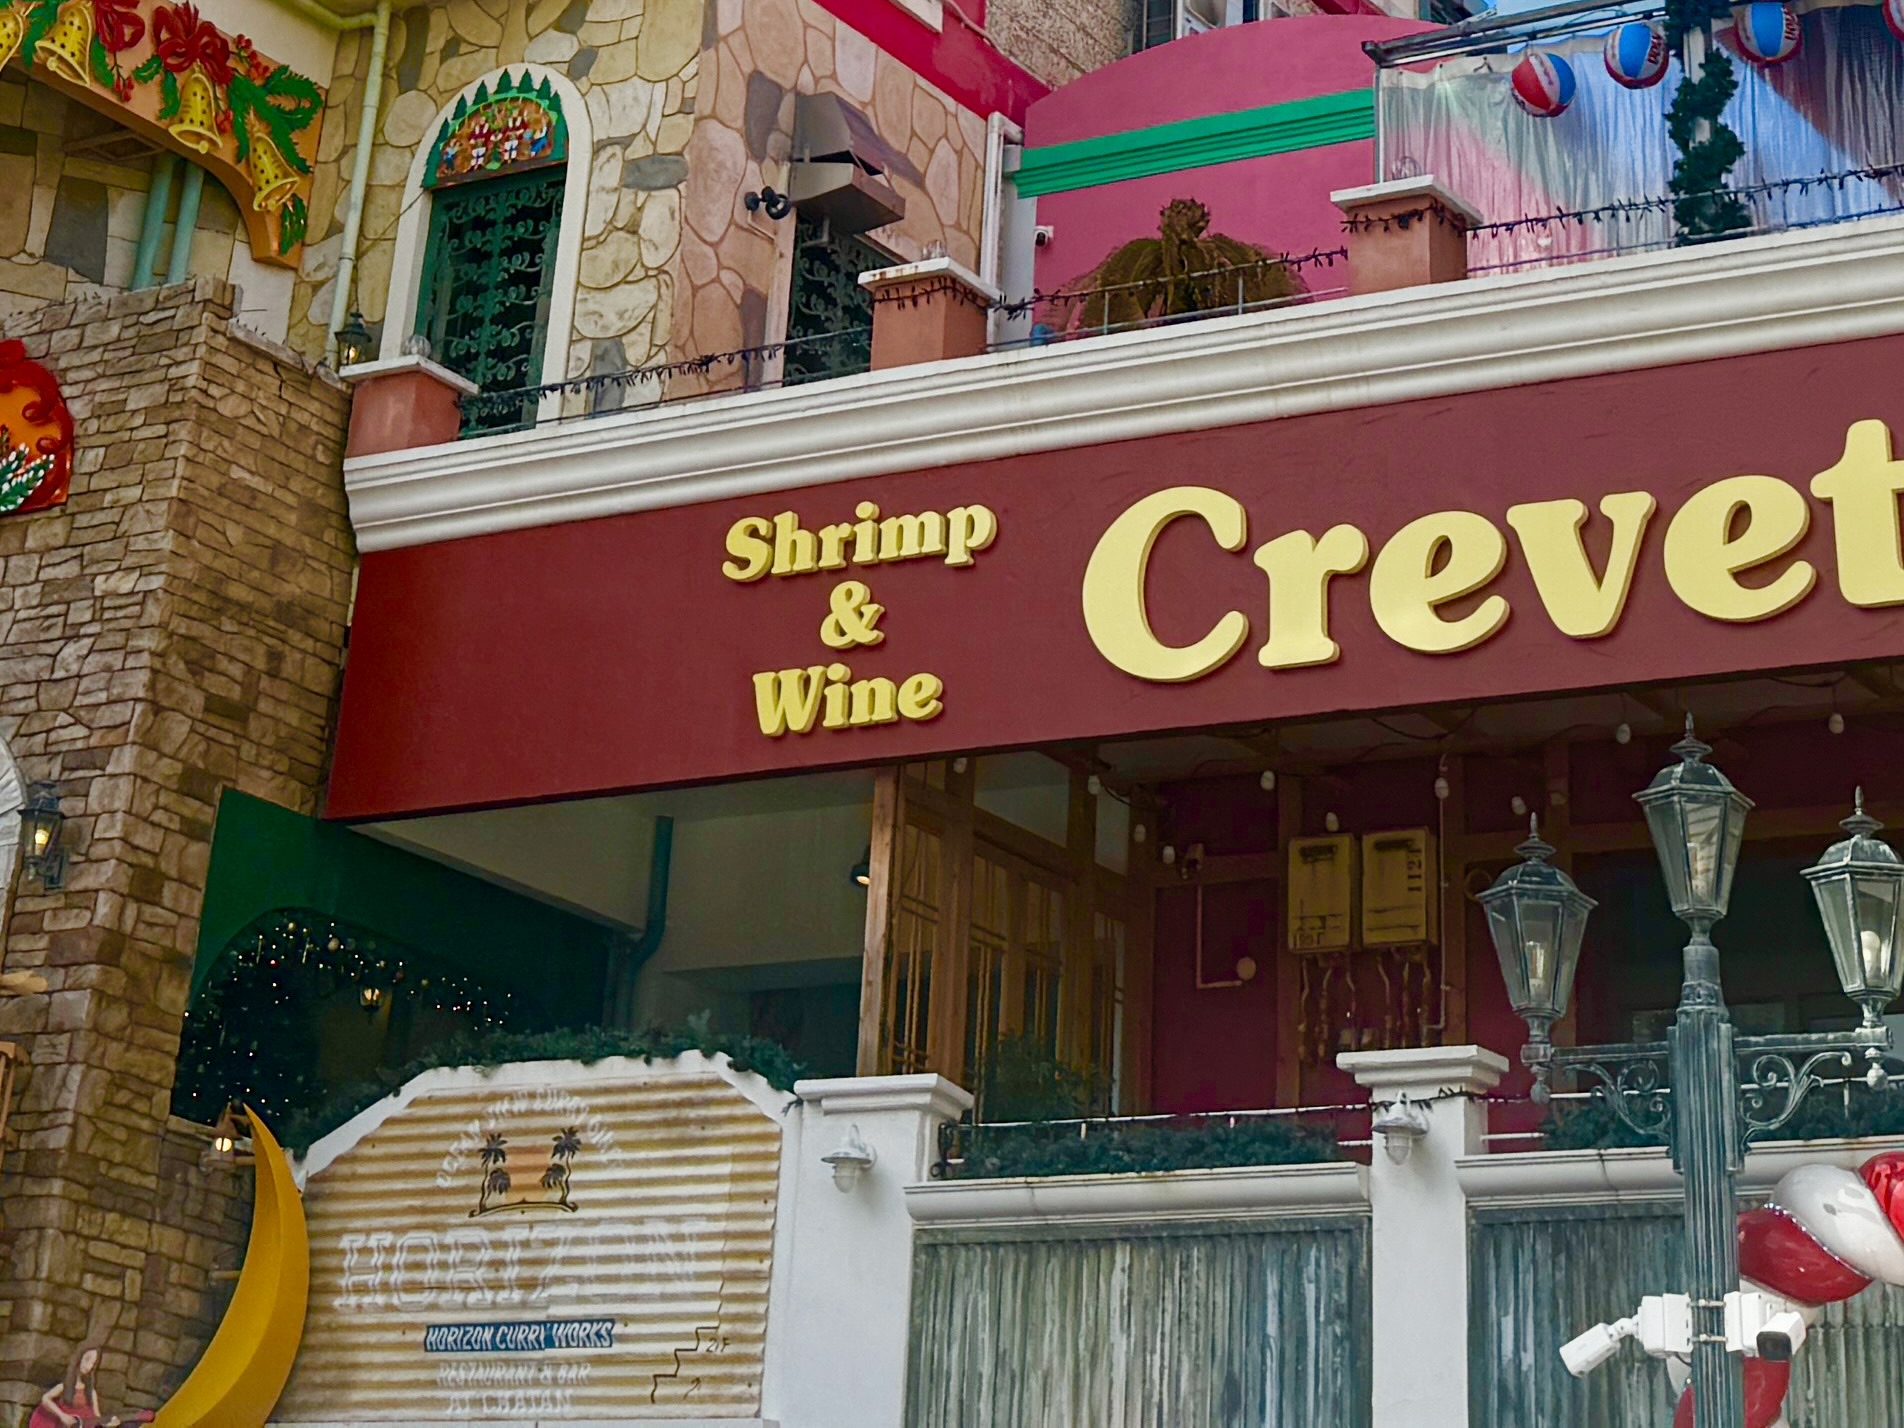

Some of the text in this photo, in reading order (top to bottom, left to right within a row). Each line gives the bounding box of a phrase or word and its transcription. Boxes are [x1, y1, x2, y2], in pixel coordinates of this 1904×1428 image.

[722, 500, 997, 583] Shrimp
[819, 580, 885, 648] &
[751, 662, 944, 737] Wine
[426, 1320, 613, 1351] HORIZON CURRY WORKS
[557, 1361, 592, 1385] BAR
